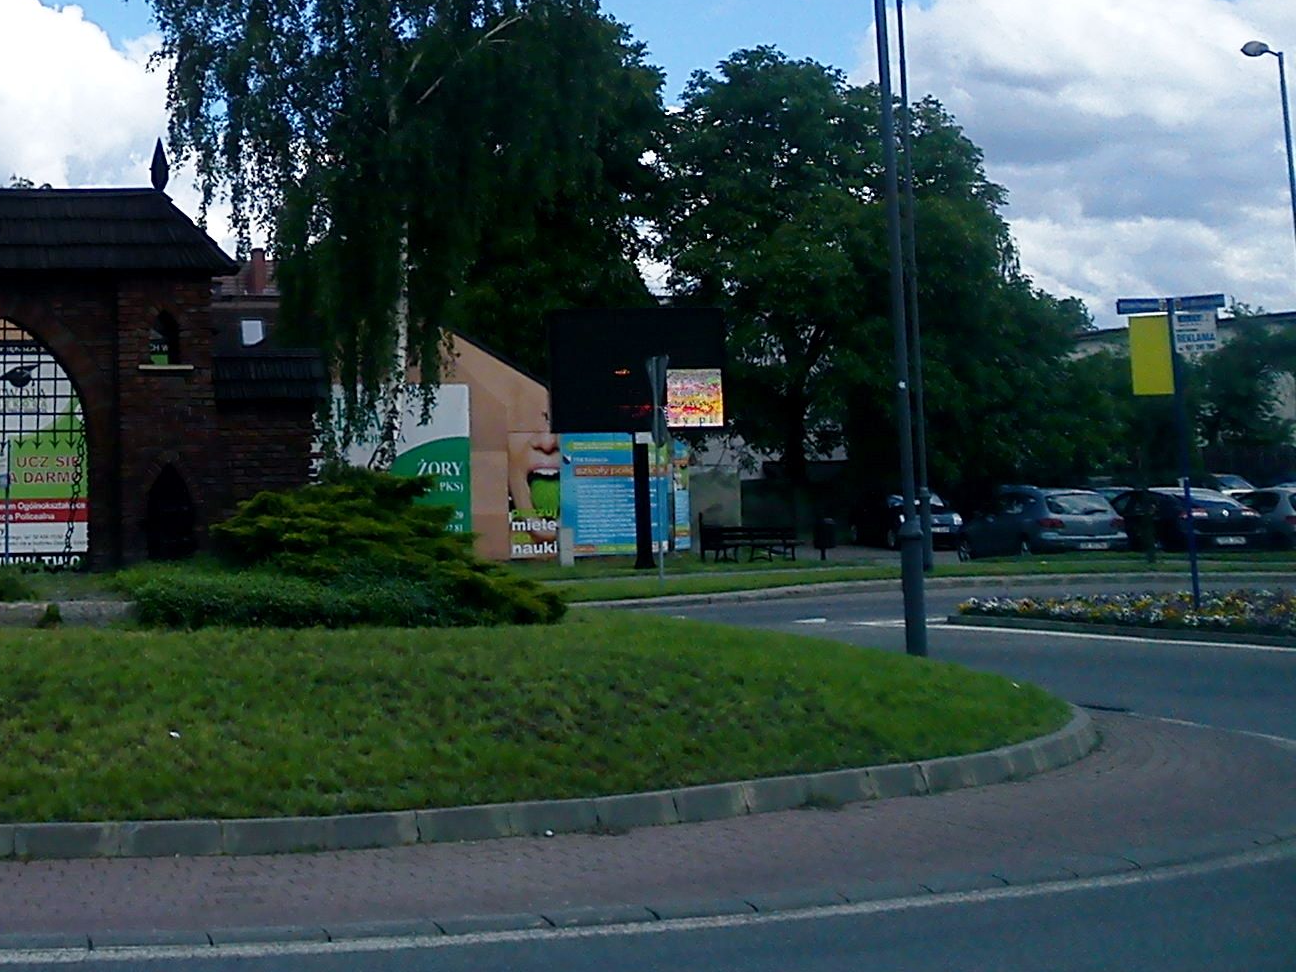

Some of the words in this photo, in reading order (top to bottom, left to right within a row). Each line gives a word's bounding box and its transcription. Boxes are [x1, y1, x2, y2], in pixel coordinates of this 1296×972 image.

[16, 457, 49, 468] UCZ
[418, 459, 464, 477] ŻORY
[512, 541, 558, 554] nauki
